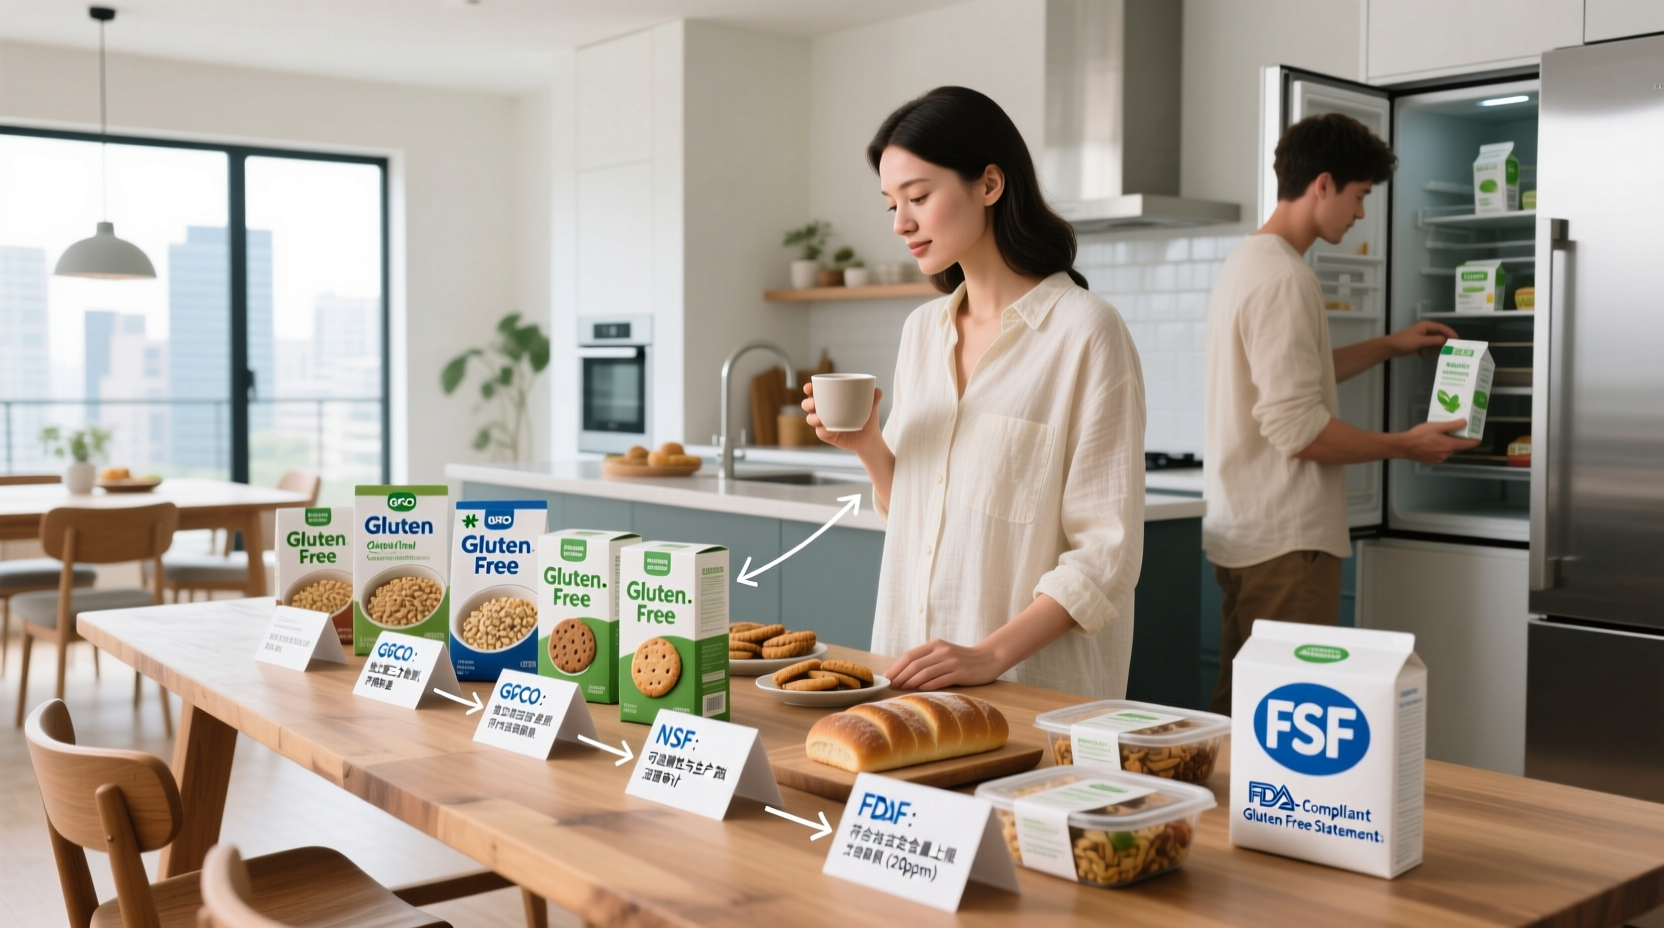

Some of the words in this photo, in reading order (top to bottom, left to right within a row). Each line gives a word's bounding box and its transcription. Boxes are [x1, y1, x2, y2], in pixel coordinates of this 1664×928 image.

[364, 515, 434, 535] Gluten
[299, 548, 337, 564] Free
[474, 556, 519, 575] Free
[553, 587, 591, 608] Free
[637, 603, 676, 625] Free
[655, 723, 700, 752] NSF:
[1265, 698, 1357, 760] FSF
[1242, 807, 1283, 826] Gluten
[1285, 814, 1313, 831] Free
